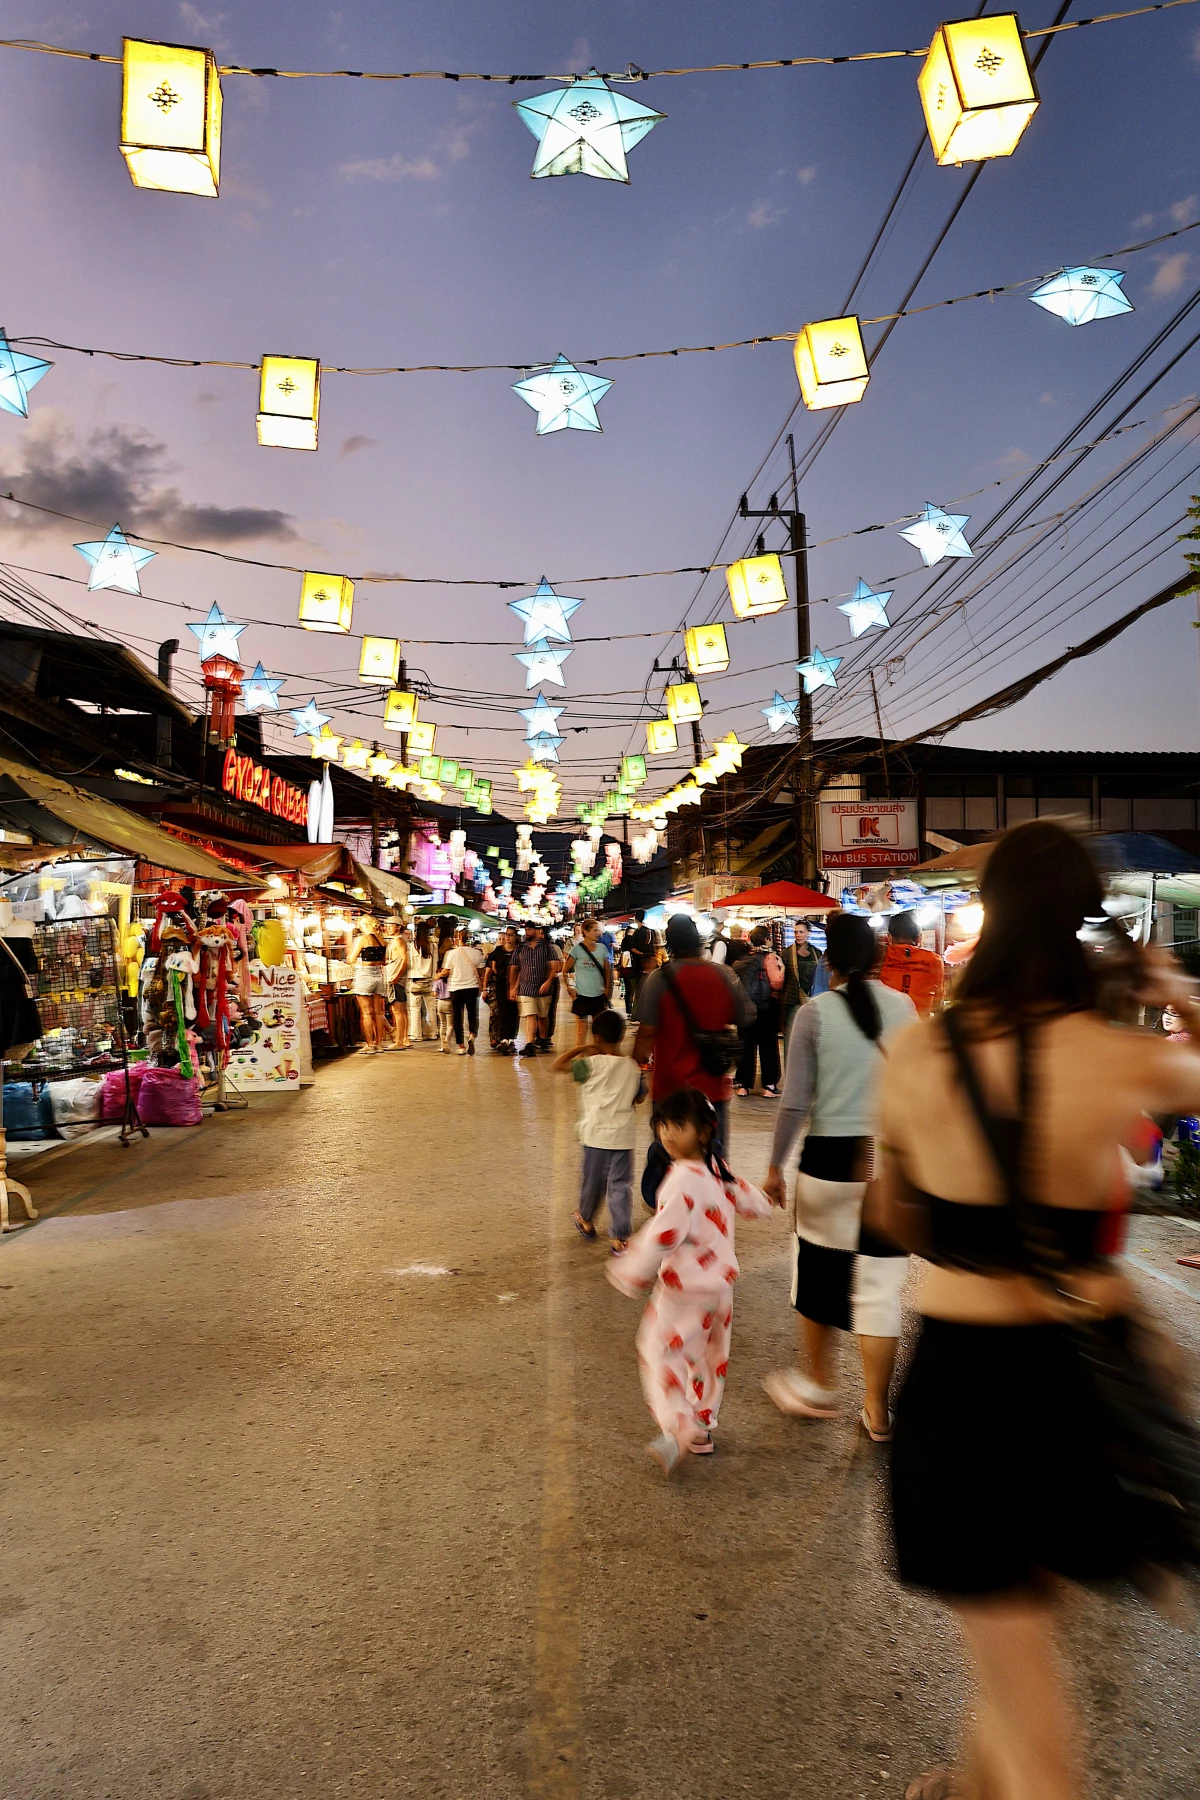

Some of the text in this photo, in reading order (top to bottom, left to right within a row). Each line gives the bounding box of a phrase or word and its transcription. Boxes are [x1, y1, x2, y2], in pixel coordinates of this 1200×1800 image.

[222, 748, 271, 813] GYOZA
[824, 852, 917, 863] PAI BUS STATION
[258, 967, 297, 986] Nice
